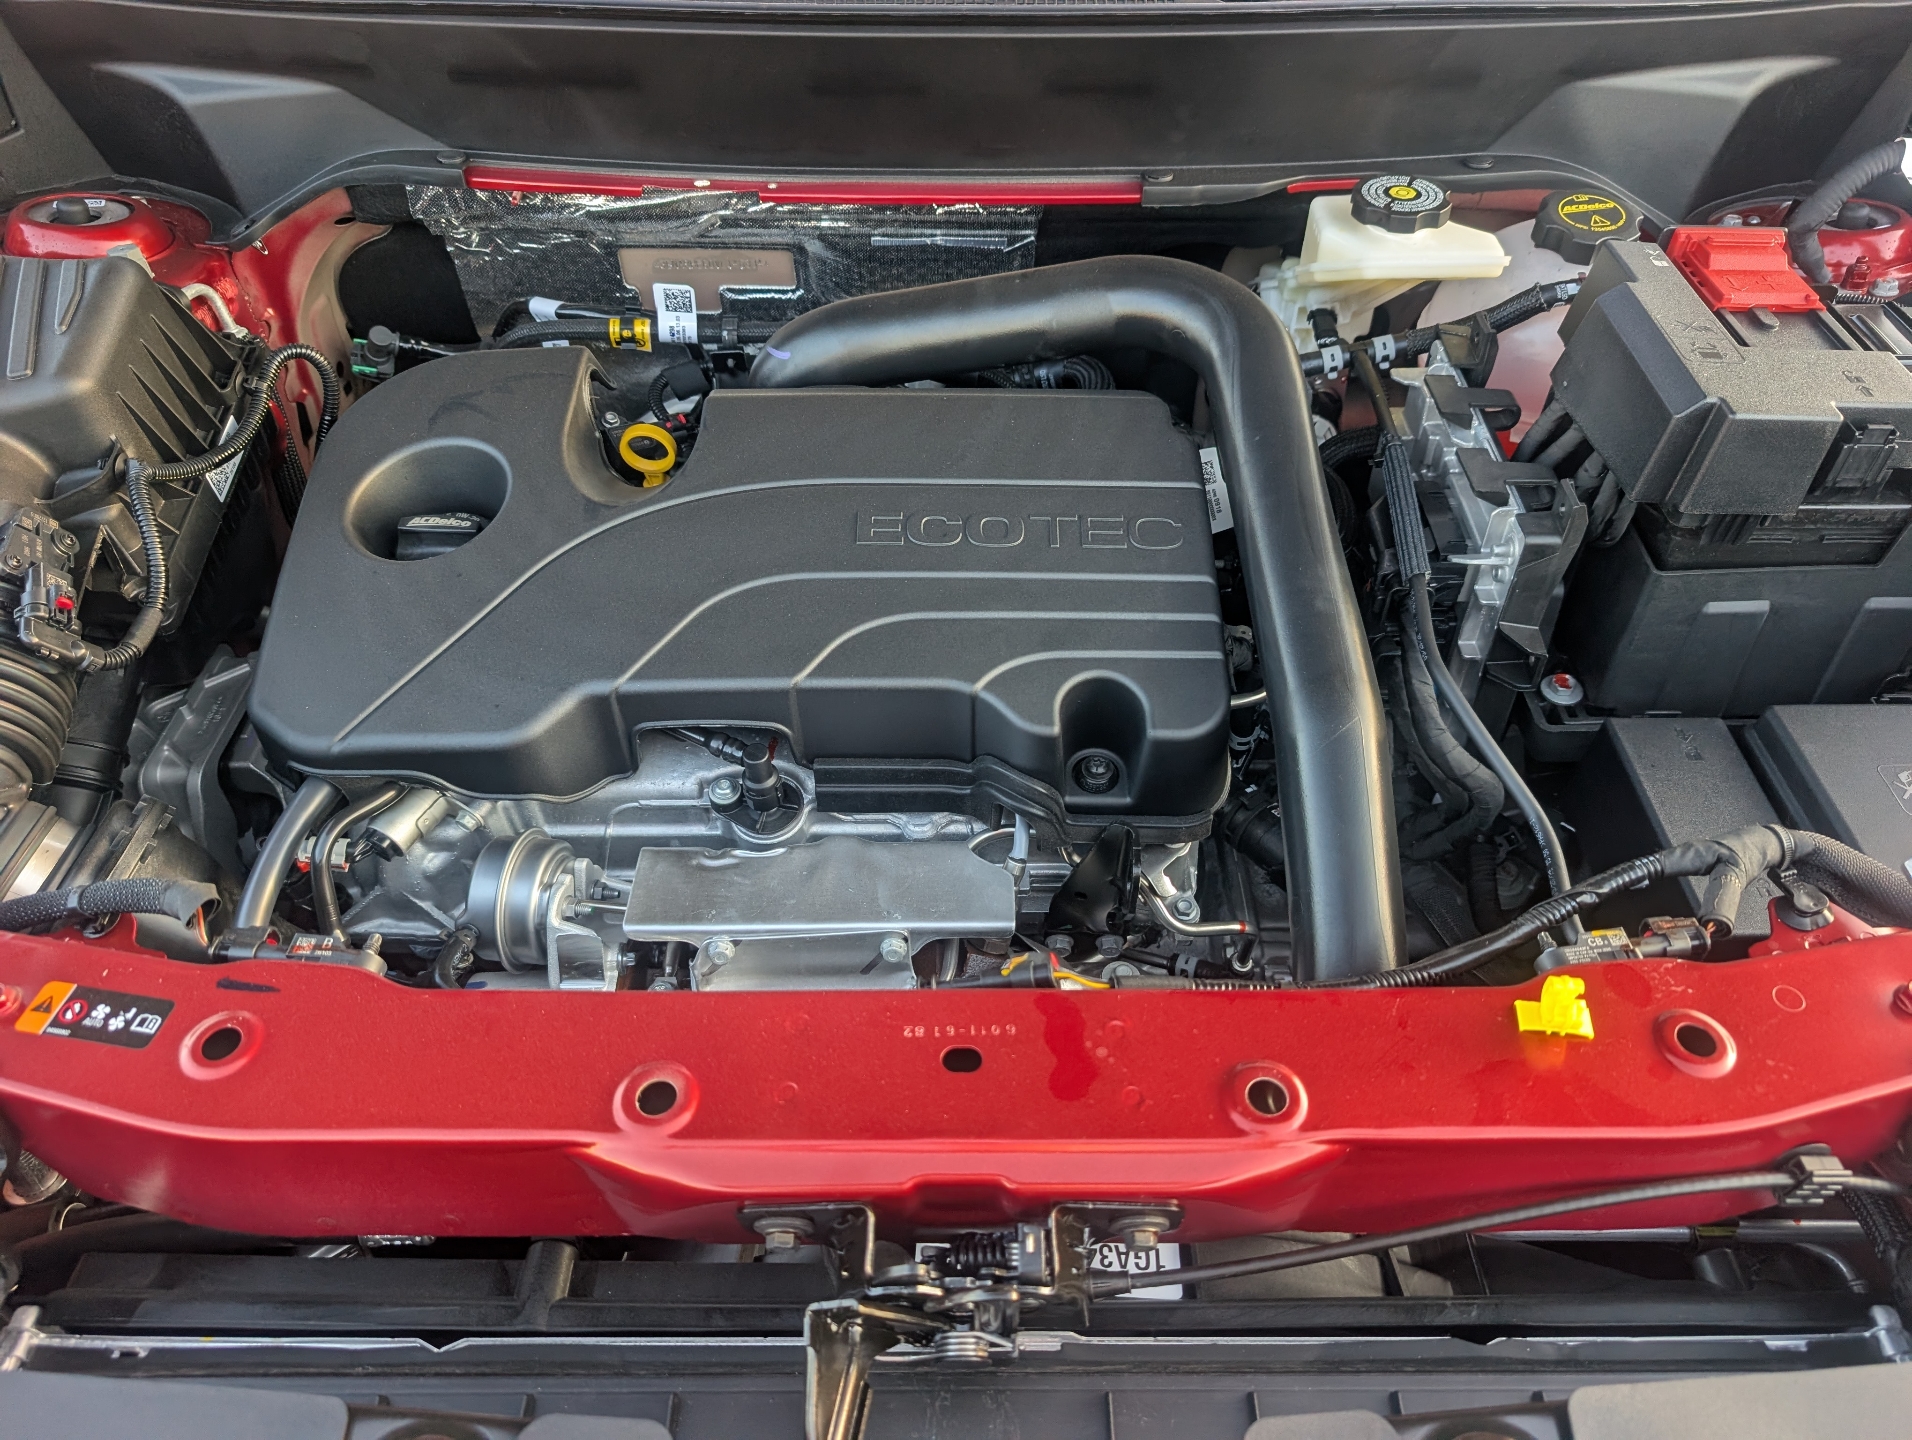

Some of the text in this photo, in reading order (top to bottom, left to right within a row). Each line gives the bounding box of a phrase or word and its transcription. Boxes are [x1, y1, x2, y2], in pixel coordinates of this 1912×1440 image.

[1562, 202, 1615, 214] ACDelco
[406, 516, 472, 527] ACDelco
[856, 510, 1185, 551] ECOTEC
[1587, 937, 1604, 947] CB
[81, 1016, 105, 1028] AUTO
